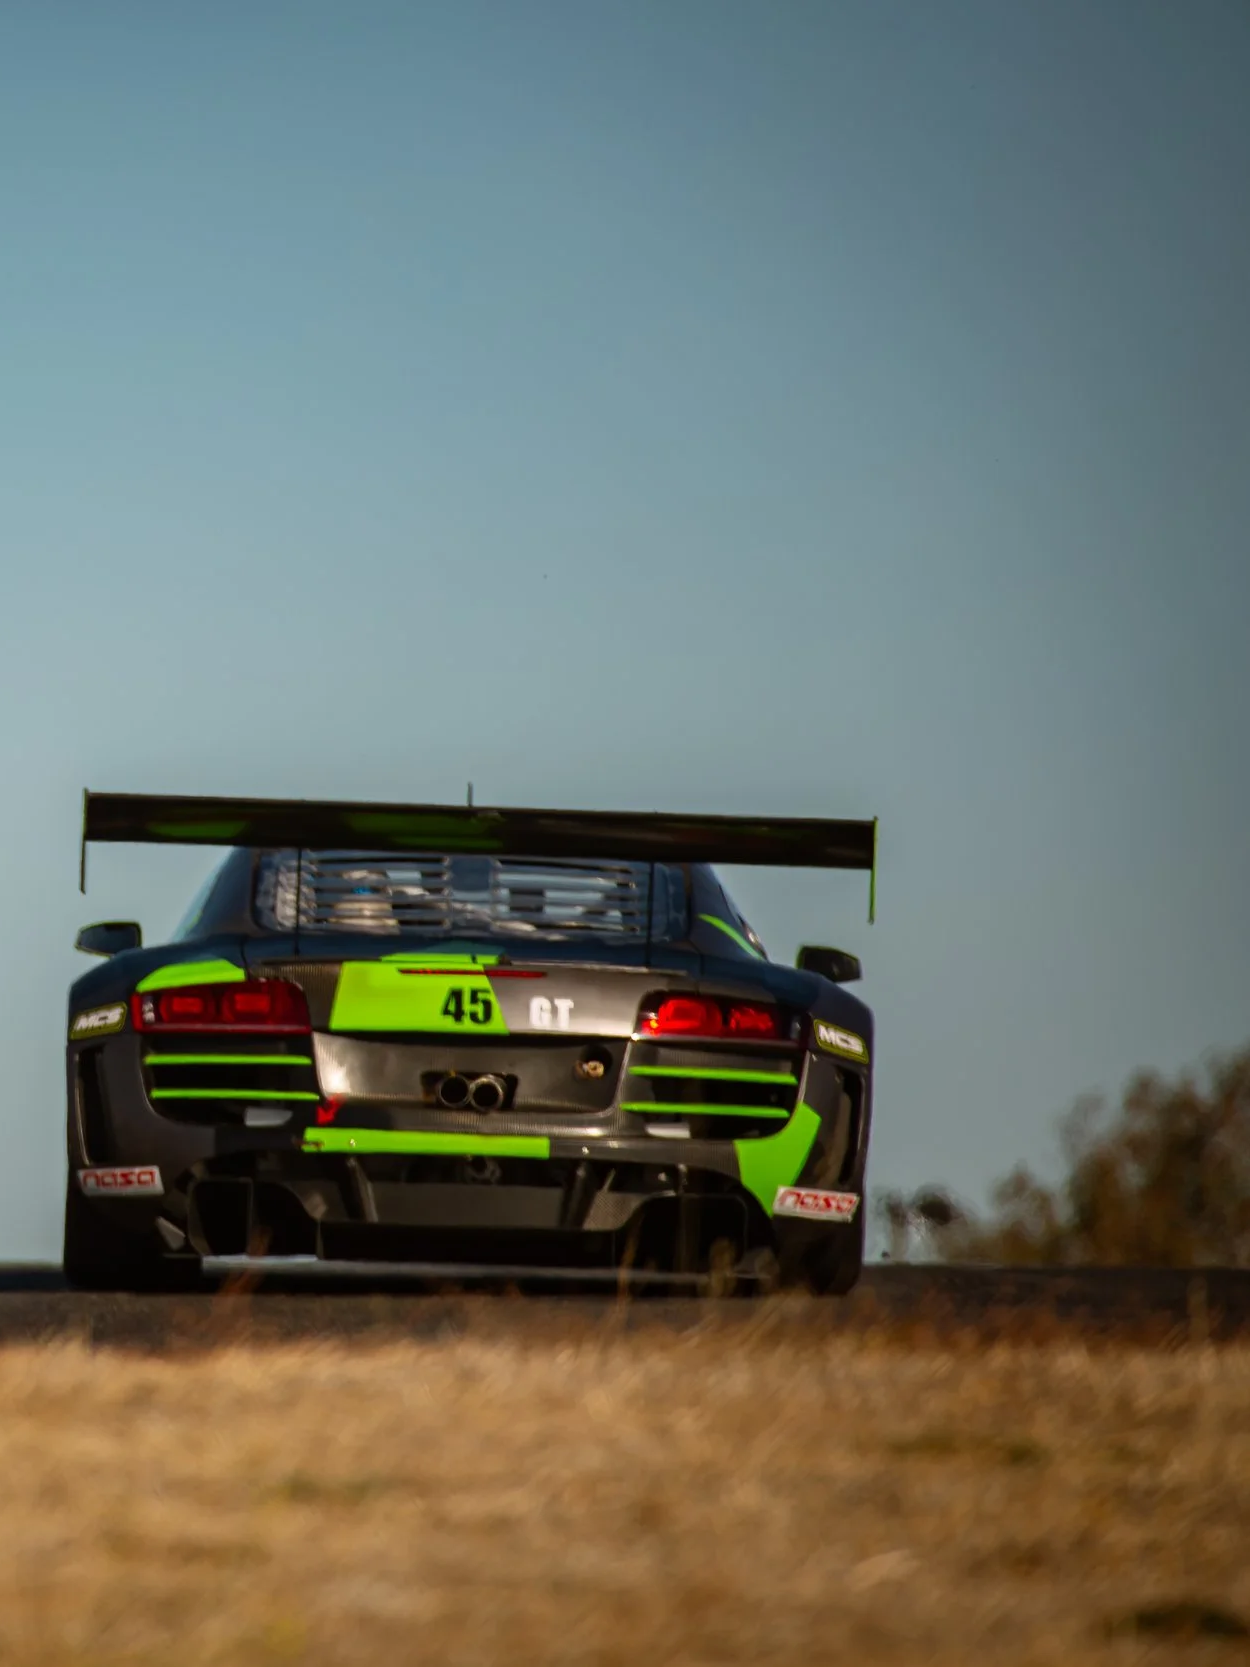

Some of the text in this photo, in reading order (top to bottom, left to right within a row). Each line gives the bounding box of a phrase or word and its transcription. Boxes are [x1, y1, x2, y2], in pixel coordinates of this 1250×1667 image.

[74, 1007, 124, 1031] MCS
[442, 987, 493, 1025] 45
[530, 996, 574, 1030] GT
[818, 1023, 864, 1055] MCS
